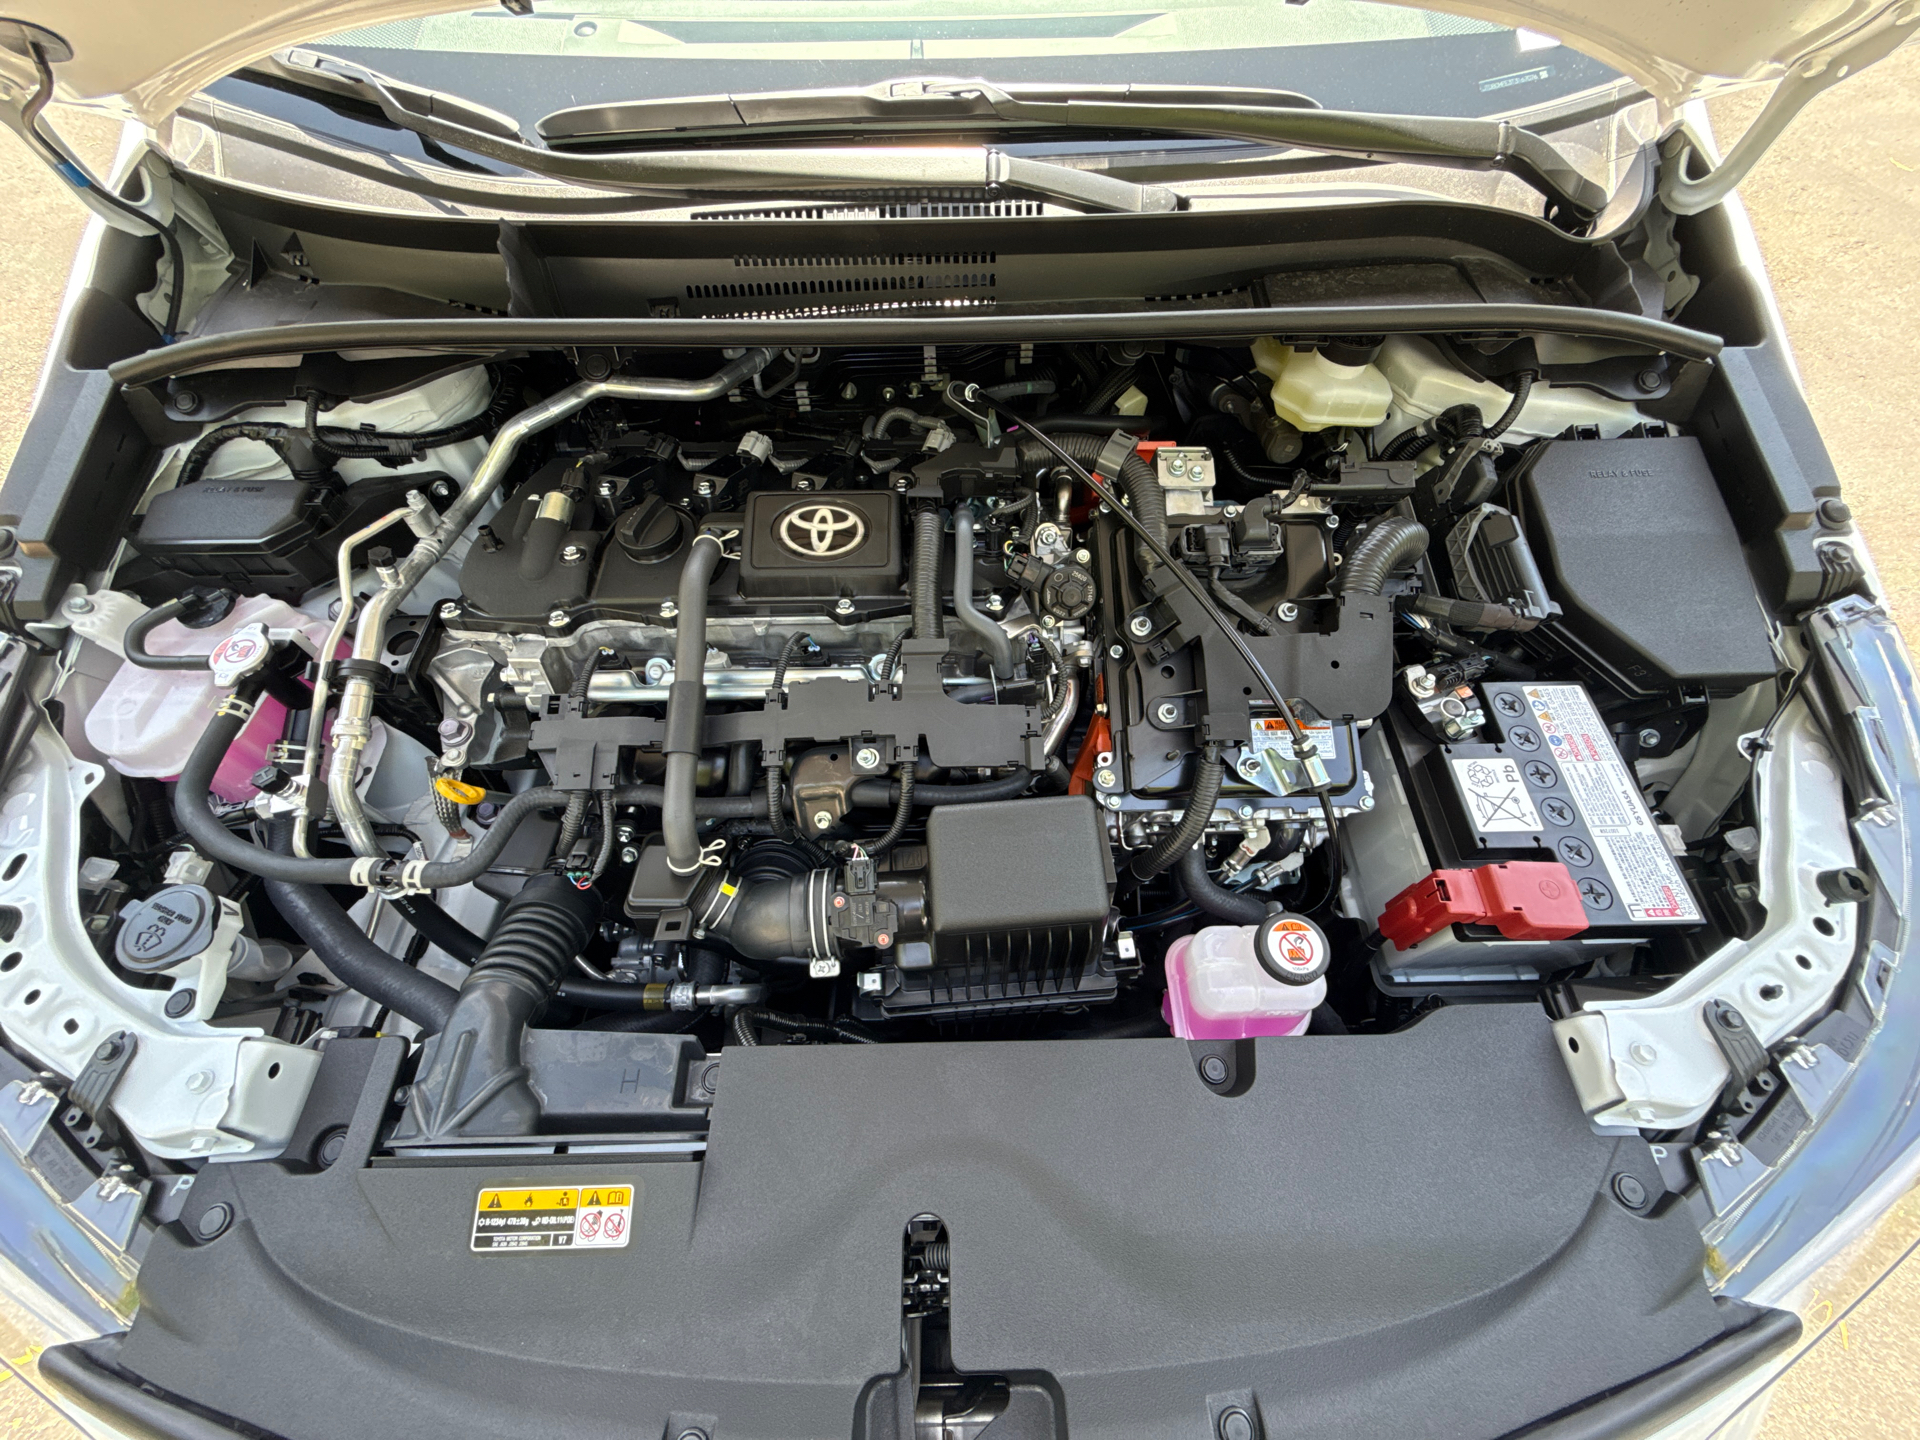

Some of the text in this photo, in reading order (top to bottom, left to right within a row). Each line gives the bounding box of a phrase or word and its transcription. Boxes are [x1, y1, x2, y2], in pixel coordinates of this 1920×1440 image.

[1589, 470, 1617, 478] RELAY
[1629, 469, 1654, 477] FUSE
[1503, 765, 1519, 782] Pb
[1620, 790, 1639, 814] YUASA
[619, 1068, 641, 1094] H
[1650, 1145, 1669, 1166] P
